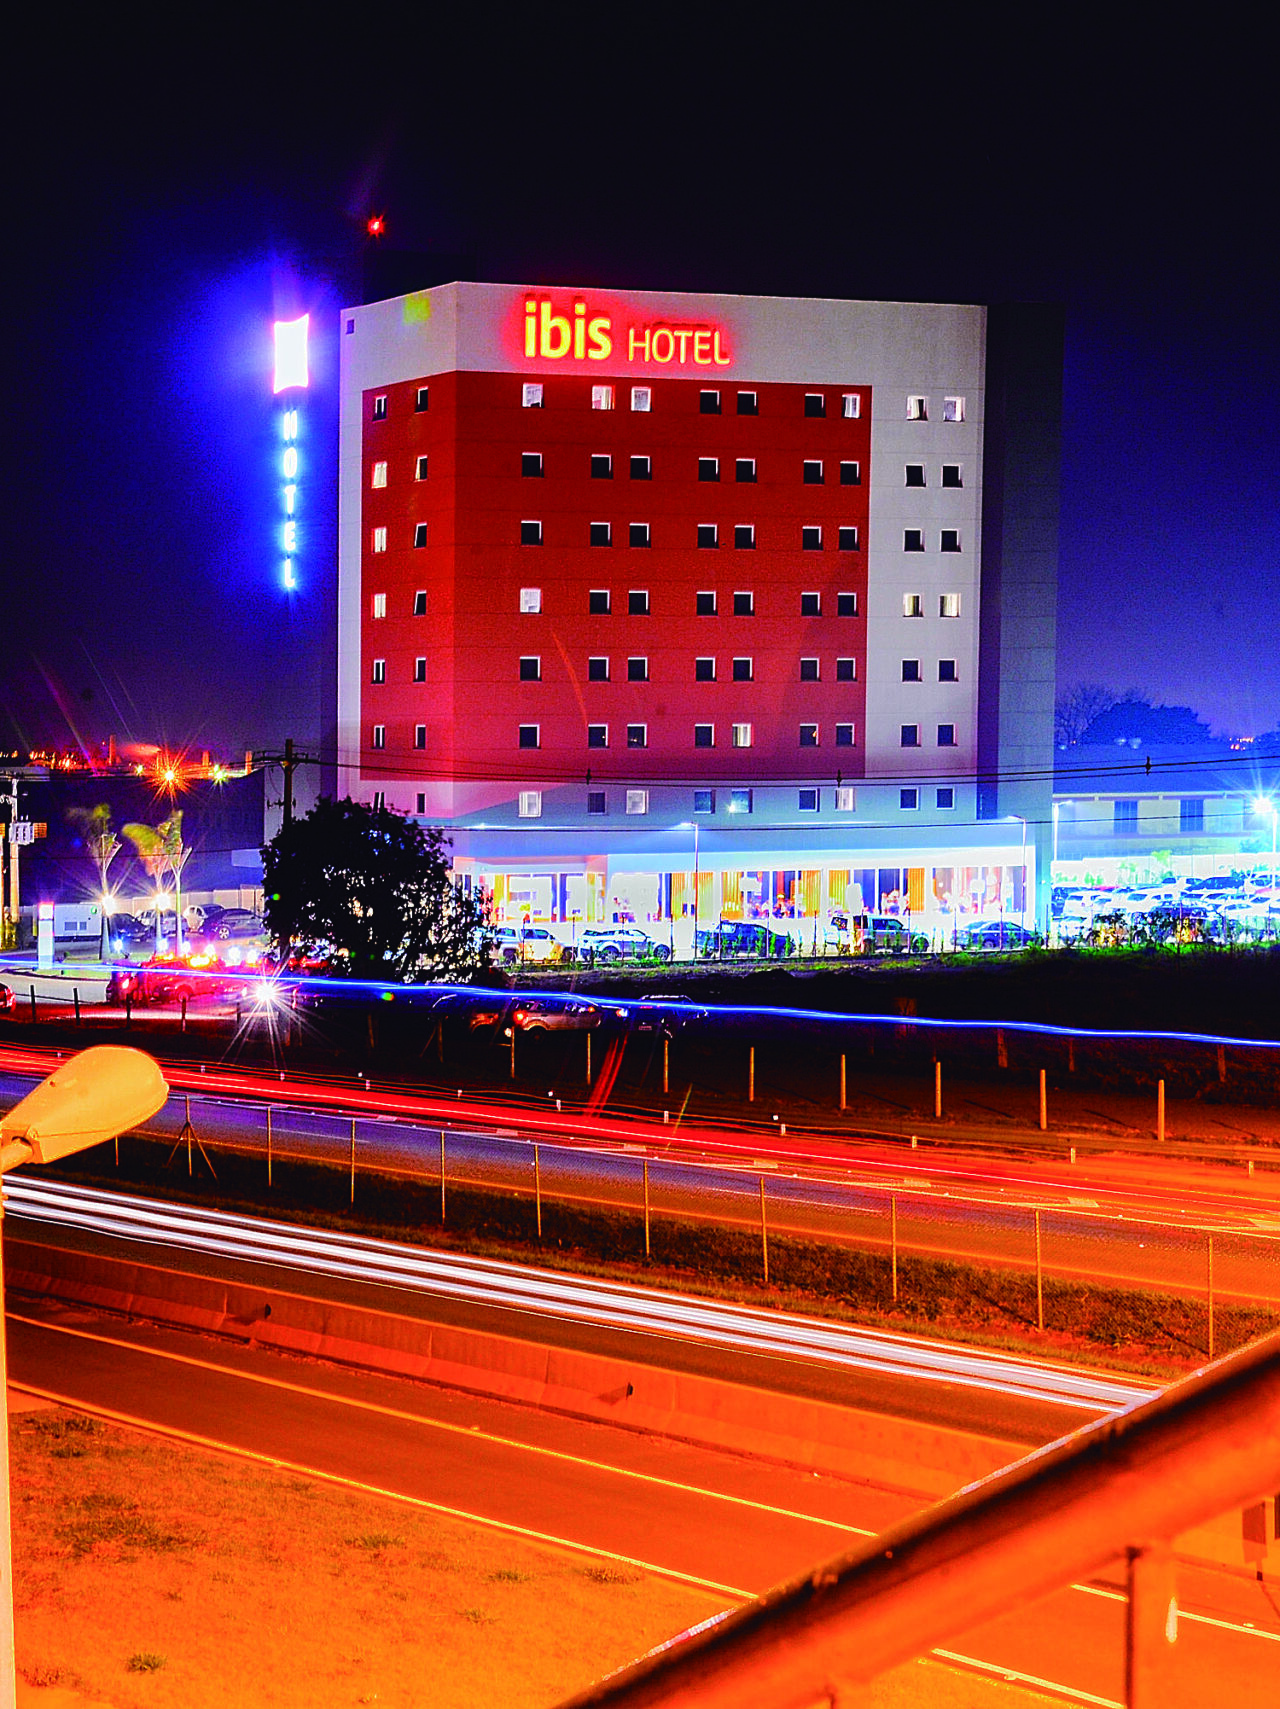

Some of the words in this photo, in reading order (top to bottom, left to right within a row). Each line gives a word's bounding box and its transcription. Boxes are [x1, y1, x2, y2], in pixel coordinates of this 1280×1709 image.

[524, 301, 612, 360] ibis
[628, 328, 731, 364] HOTEL
[283, 409, 298, 588] HOTEL
